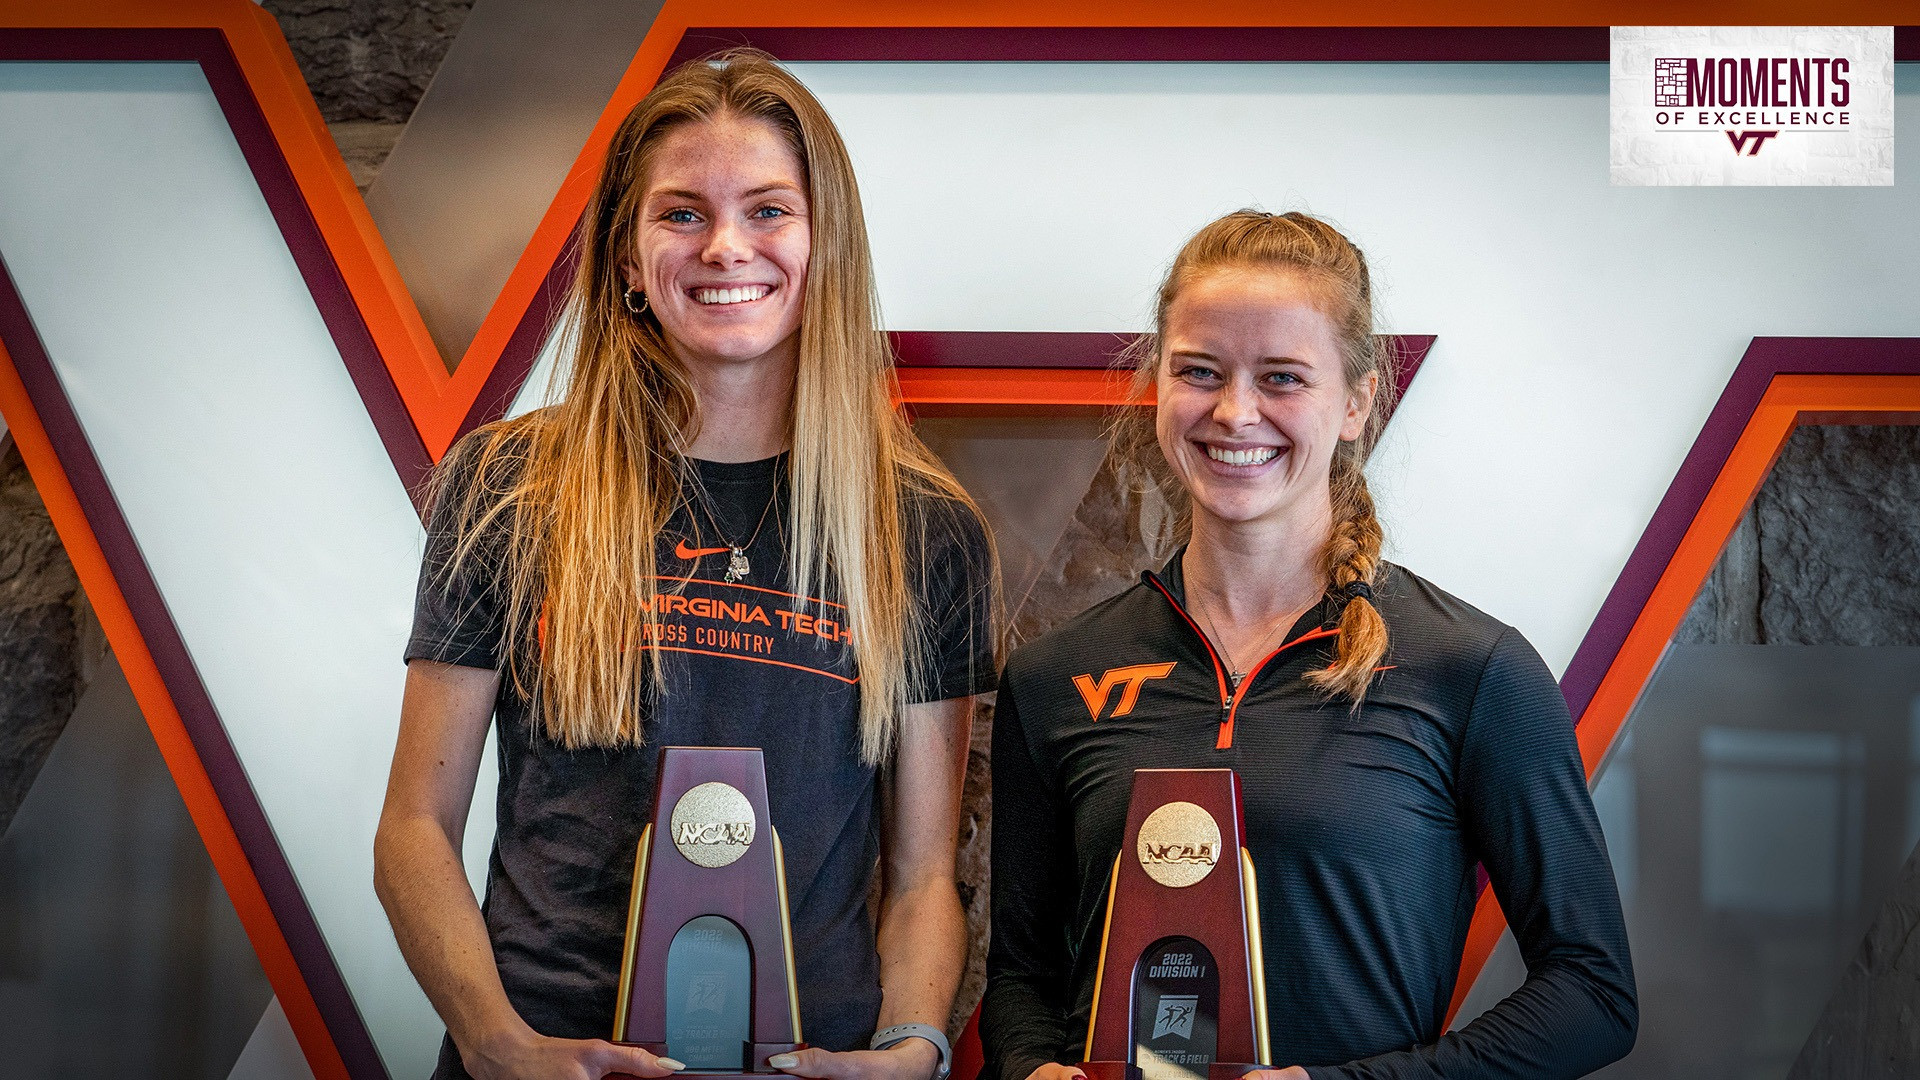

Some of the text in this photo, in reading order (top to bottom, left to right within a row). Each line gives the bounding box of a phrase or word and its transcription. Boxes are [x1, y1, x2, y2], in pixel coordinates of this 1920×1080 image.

[775, 608, 853, 645] TECH
[642, 623, 775, 655] ROSS COUNTRY
[1071, 660, 1178, 722] VT
[677, 821, 752, 846] NCAA
[1142, 842, 1215, 866] NCAA
[1149, 965, 1199, 978] DIVISION
[1162, 953, 1193, 966] 2022
[1152, 1054, 1209, 1065] TRACK & FIELD
